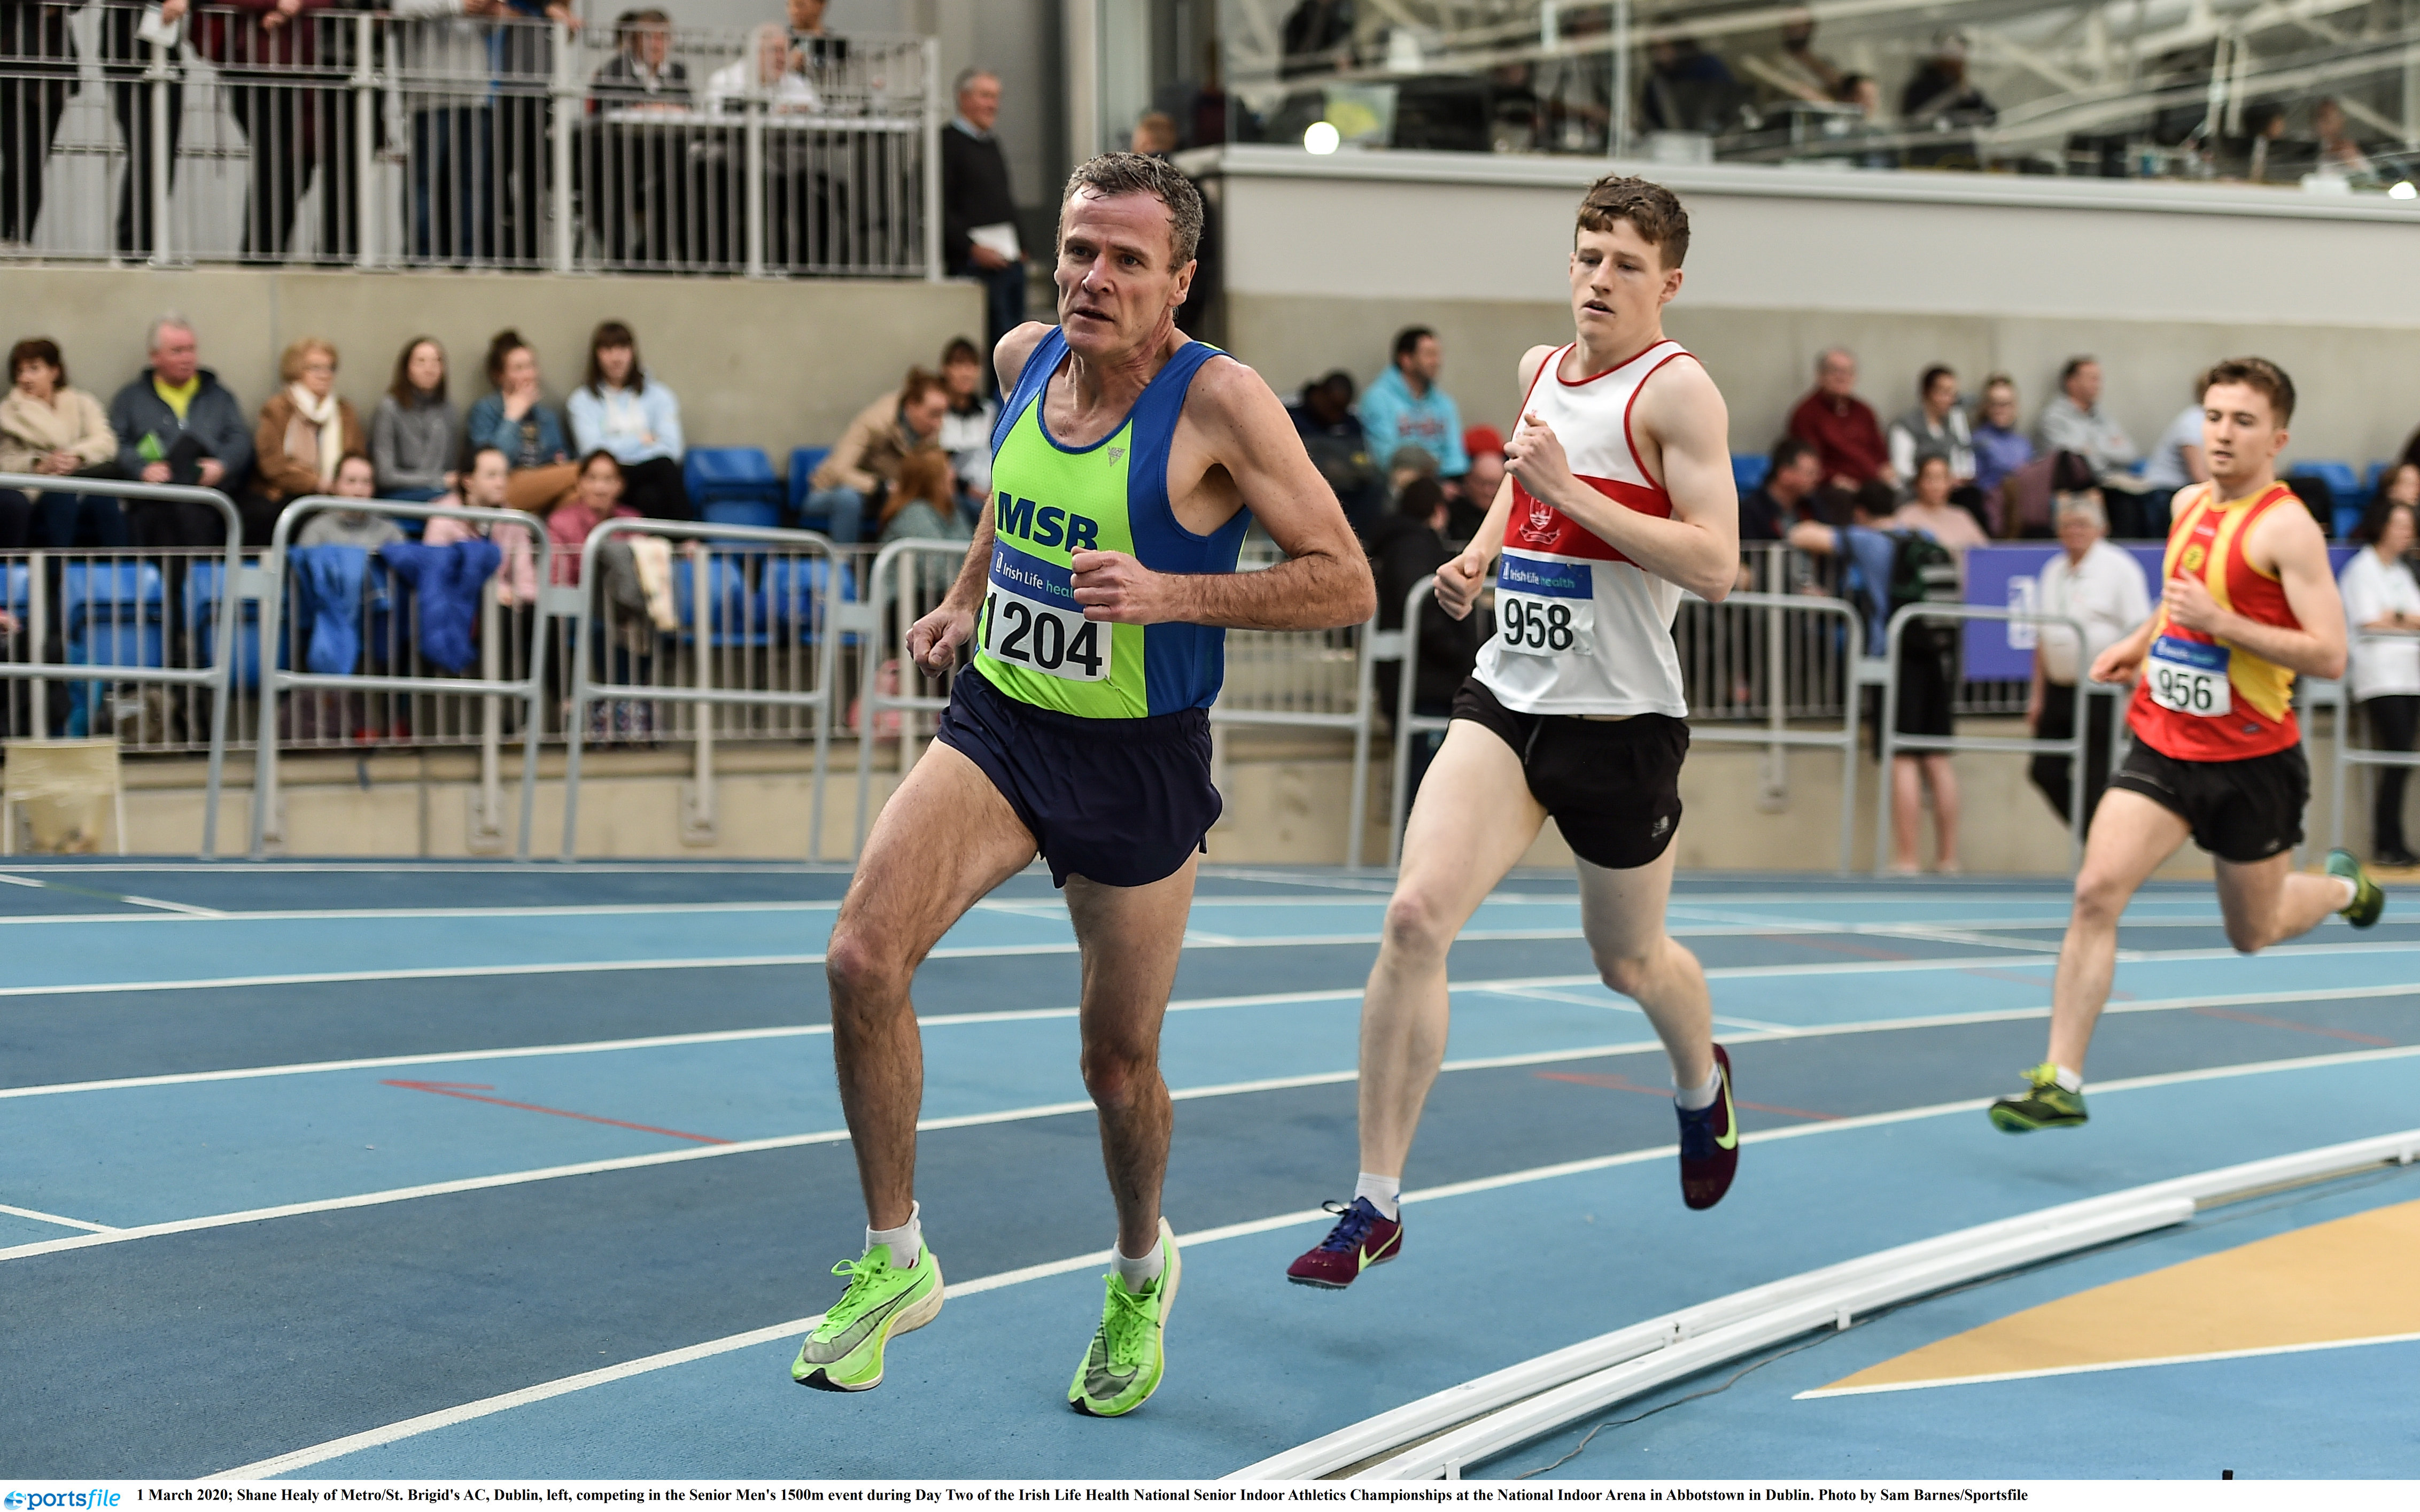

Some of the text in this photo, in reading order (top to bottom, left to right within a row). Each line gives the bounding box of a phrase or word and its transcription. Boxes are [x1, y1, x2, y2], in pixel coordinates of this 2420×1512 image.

[997, 491, 1099, 553] MSB
[1003, 562, 1074, 599] Irish Life heal
[1510, 569, 1575, 588] Irish Life health
[984, 591, 1103, 676] 1204
[1503, 598, 1573, 651] 958
[2158, 669, 2213, 711] 956
